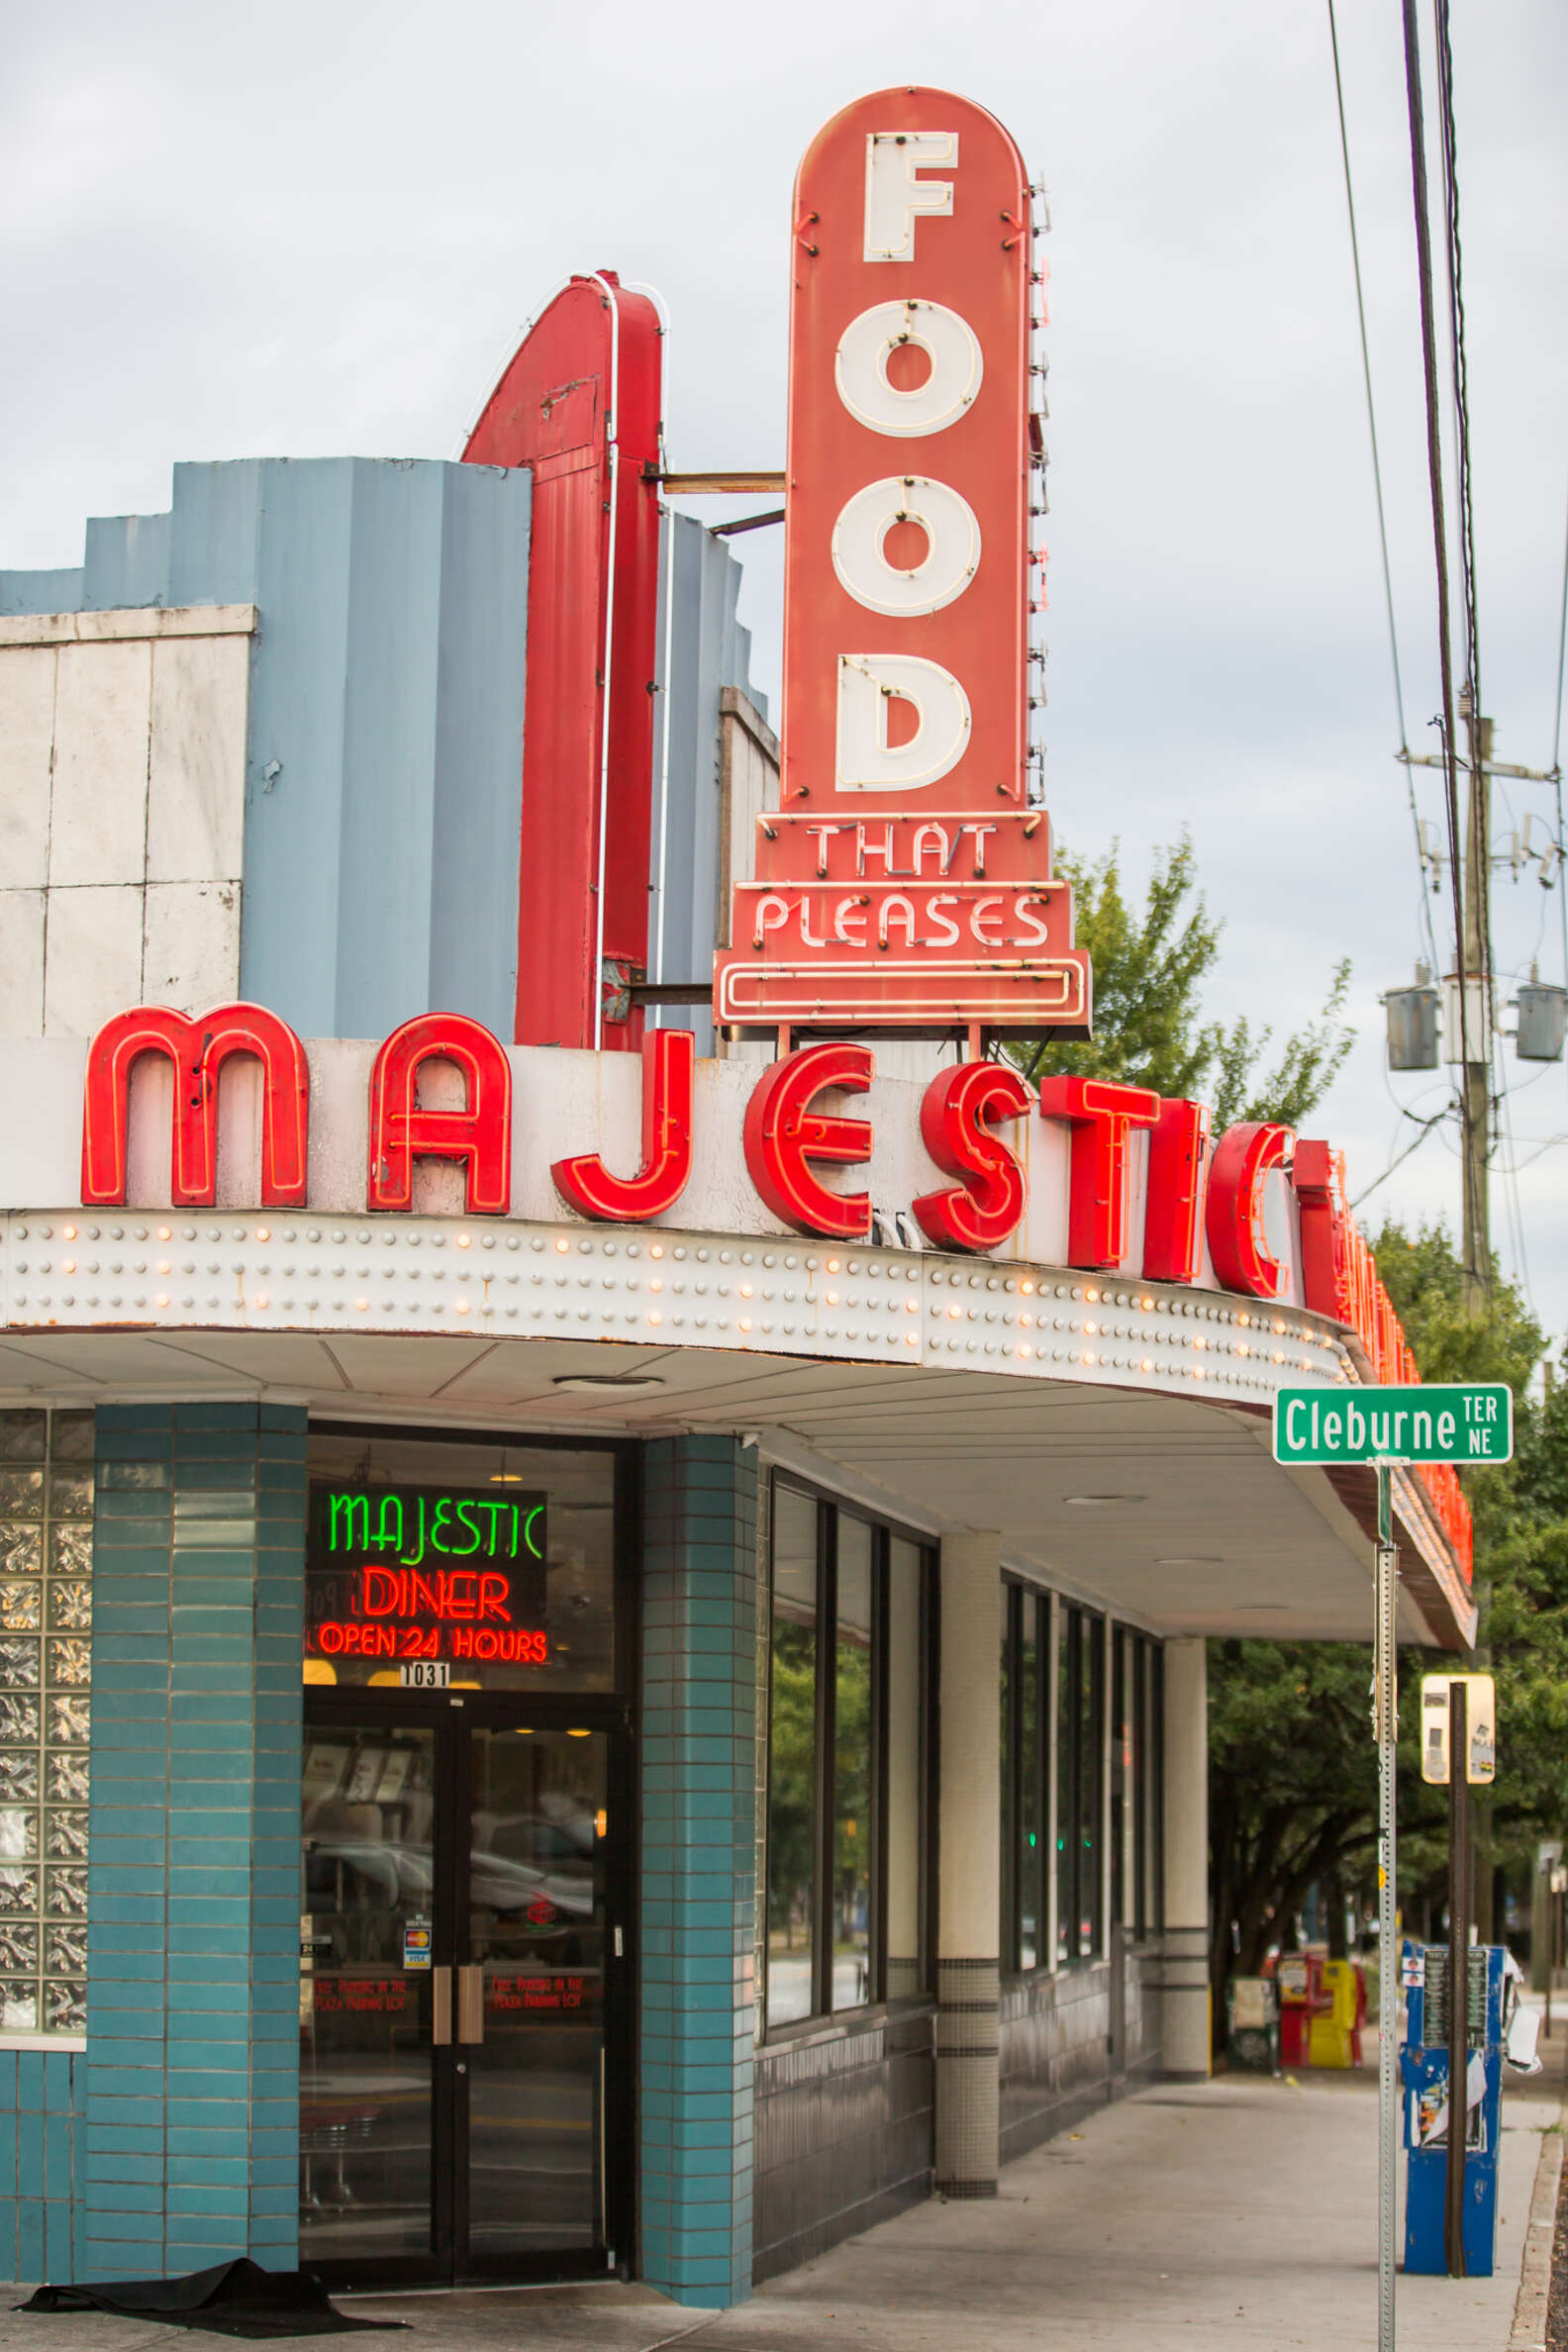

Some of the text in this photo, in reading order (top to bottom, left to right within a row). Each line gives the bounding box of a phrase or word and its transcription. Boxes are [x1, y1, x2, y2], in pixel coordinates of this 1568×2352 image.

[832, 132, 984, 792] FOOD
[807, 822, 997, 876] THAT
[754, 894, 1048, 947] PLEASES
[81, 1001, 1296, 1299] MAJESTIC
[1286, 1396, 1497, 1450] Cleburne TER
[1469, 1428, 1492, 1454] NE
[330, 1494, 543, 1565] MAJESTIC
[362, 1566, 512, 1621] DINER
[319, 1622, 547, 1663] OPEN 24 HOURS
[404, 1663, 447, 1686] 1031
